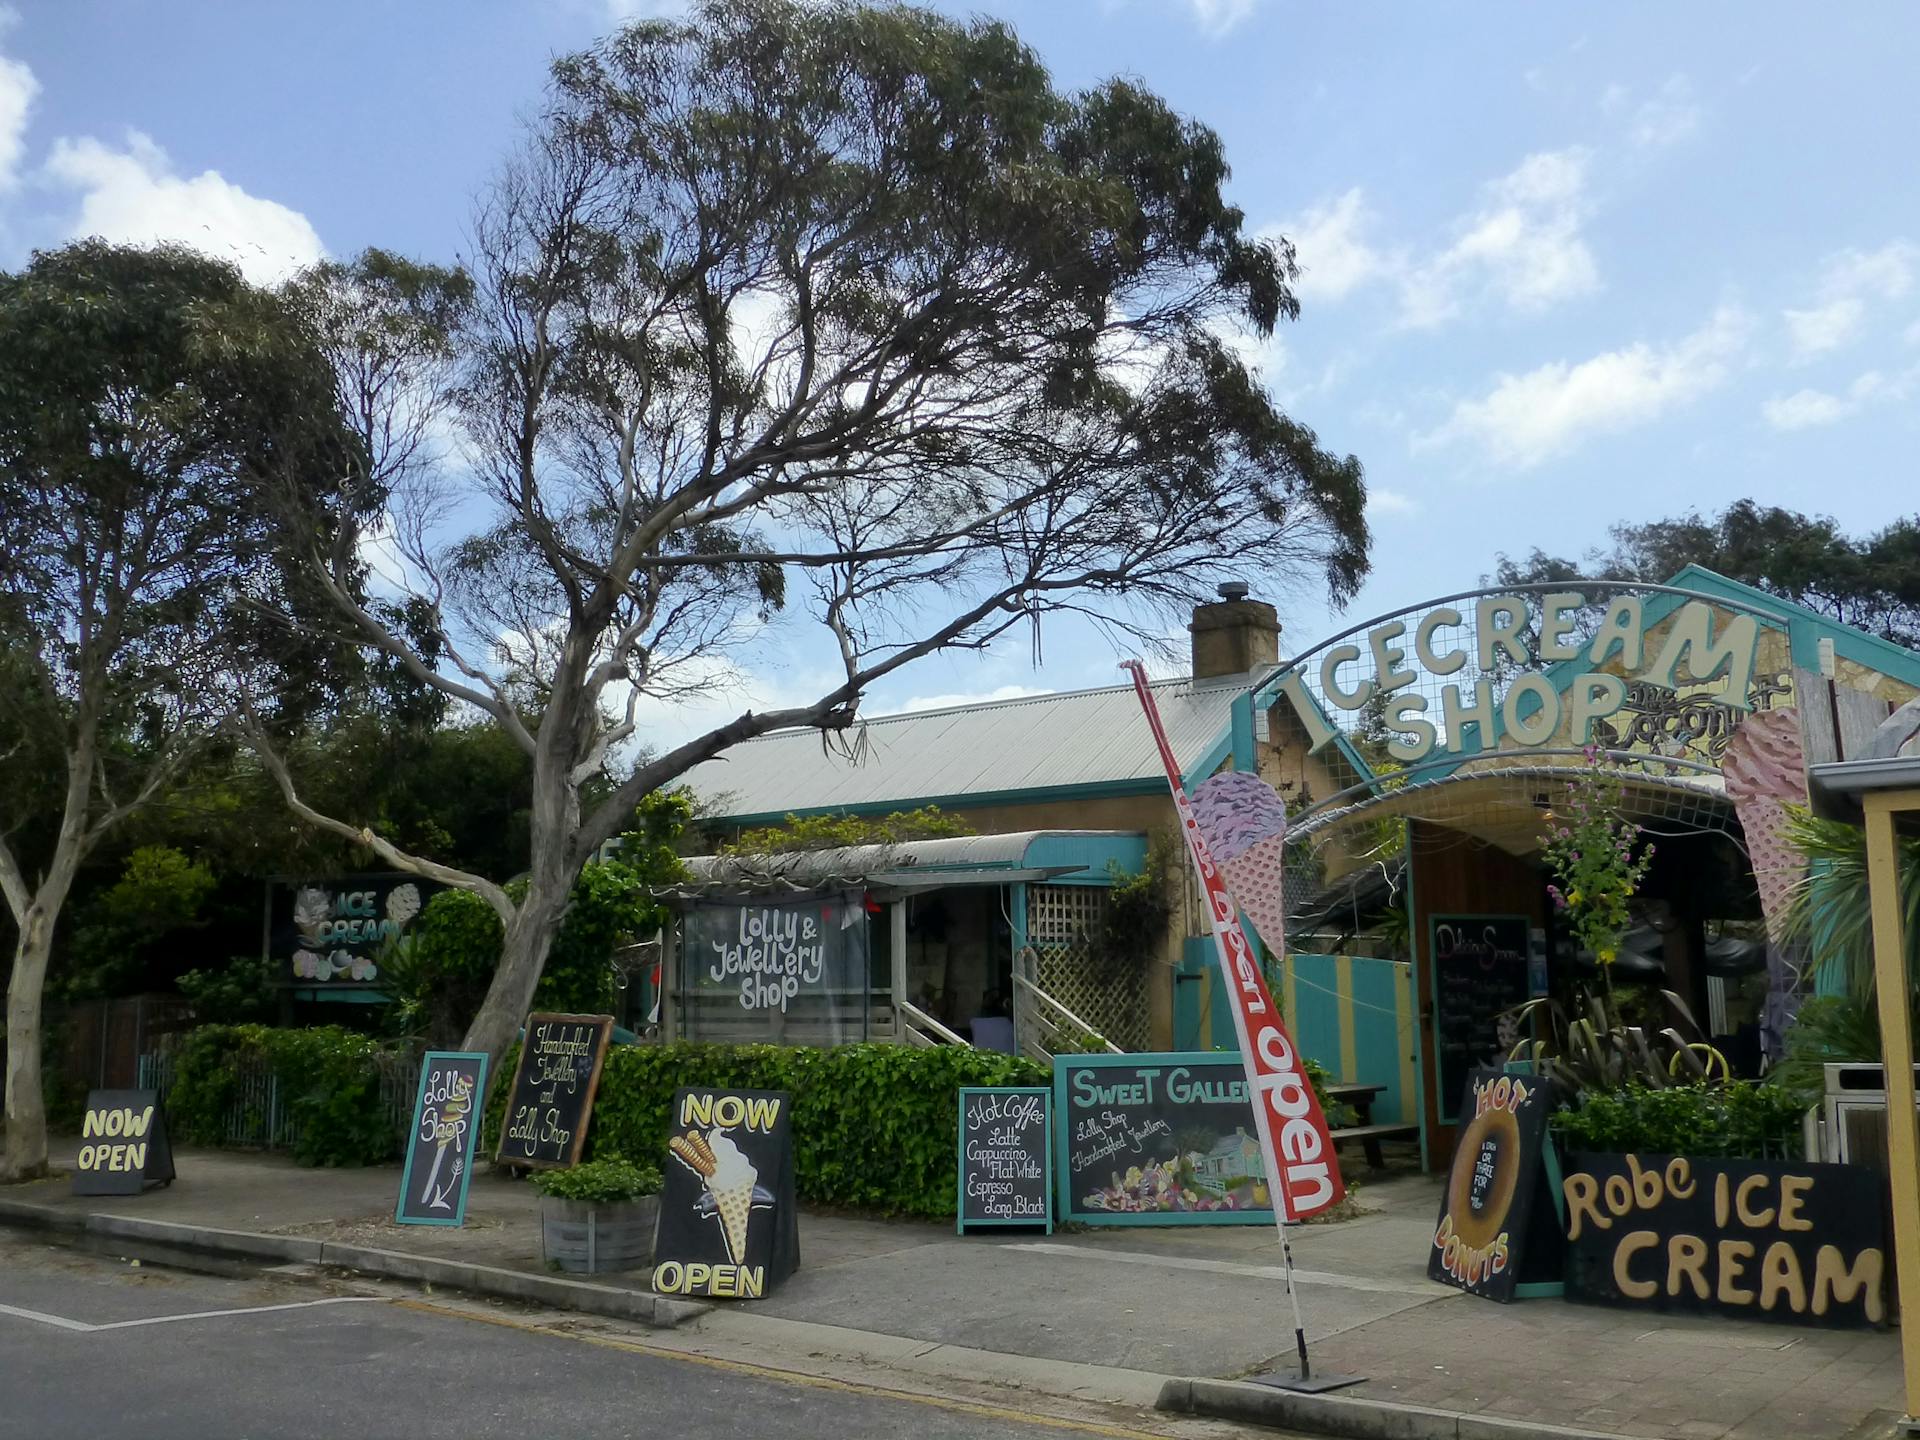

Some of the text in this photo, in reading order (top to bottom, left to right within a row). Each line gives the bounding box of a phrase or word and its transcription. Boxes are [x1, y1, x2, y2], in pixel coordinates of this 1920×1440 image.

[1278, 592, 1760, 756] ICECREAM
[1386, 673, 1626, 763] SHOP
[336, 890, 377, 917] ICE
[318, 918, 402, 944] CREAM
[739, 906, 817, 954] Lolly &
[710, 940, 824, 984] Jewellery
[533, 1022, 594, 1068] Handcrafted
[423, 1070, 474, 1114] Lolly
[529, 1056, 577, 1095] Jewellery
[539, 1082, 557, 1104] and
[1073, 1067, 1161, 1108] SWEET
[82, 1105, 154, 1139] NOW
[420, 1107, 467, 1153] Shop
[680, 1093, 780, 1134] NOW
[967, 1094, 1045, 1131] Hot Coffee
[1076, 1110, 1129, 1141] Lolly Shop
[1257, 1025, 1335, 1213] open
[508, 1105, 571, 1161] Lolly Shop
[987, 1126, 1021, 1146] Latte
[1071, 1119, 1173, 1173] Handcrafted Jewellery
[78, 1142, 147, 1172] OPEN
[966, 1139, 1027, 1168] Cappuccino
[989, 1155, 1042, 1179] Flat White
[1476, 1161, 1495, 1179] THREE
[1481, 1152, 1492, 1164] OR
[967, 1172, 1013, 1202] Espresso
[1473, 1174, 1488, 1189] FOR
[1562, 1153, 1814, 1241] Robe ICE
[984, 1194, 1045, 1219] Long Black
[1434, 1214, 1509, 1287] DONUTS
[651, 1260, 765, 1298] OPEN
[1612, 1230, 1884, 1323] CREAM
